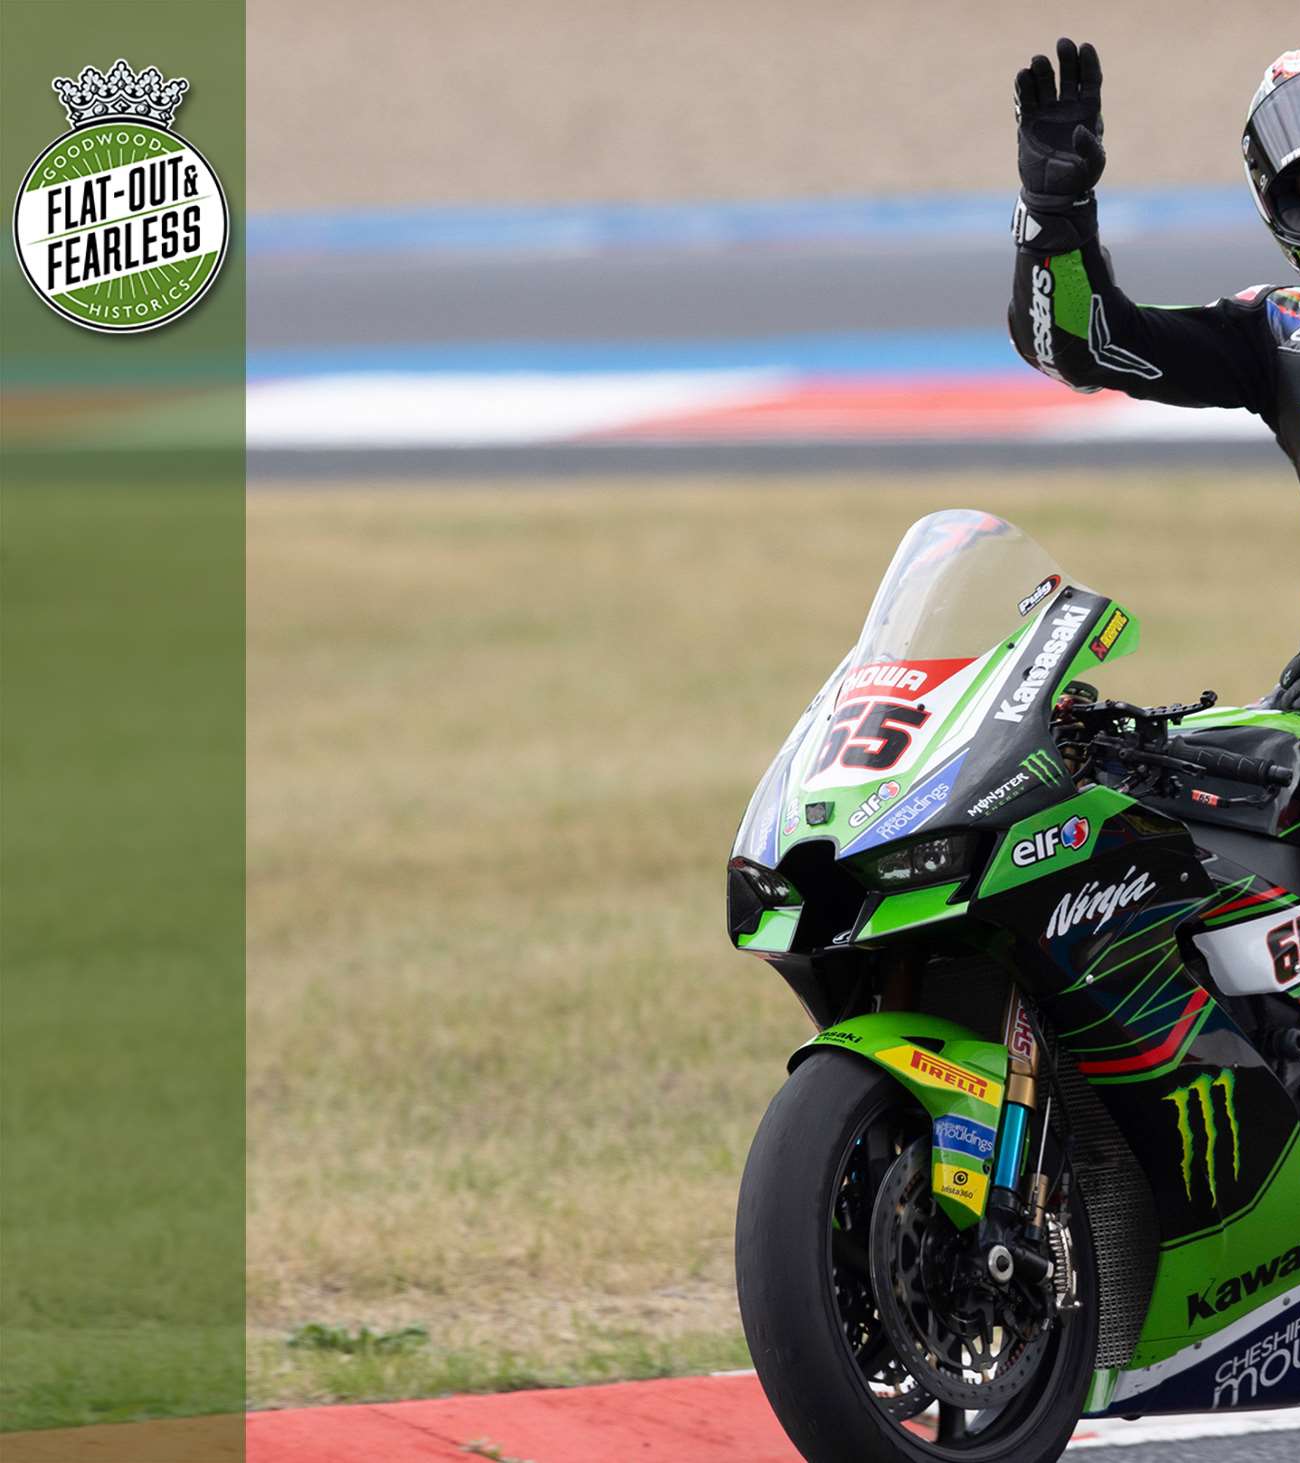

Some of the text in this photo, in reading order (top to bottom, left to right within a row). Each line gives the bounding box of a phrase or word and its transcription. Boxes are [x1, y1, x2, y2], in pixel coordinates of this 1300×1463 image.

[1018, 580, 1052, 616] Puig
[994, 604, 1091, 723] Kawasaki
[815, 700, 932, 771] 65
[849, 794, 882, 828] elf
[880, 783, 950, 840] mouldings
[967, 772, 1029, 816] MONSTER
[1013, 827, 1059, 866] elf
[1046, 865, 1156, 939] Ninja
[911, 1050, 988, 1098] PIRELLI
[936, 1122, 993, 1152] mouldings
